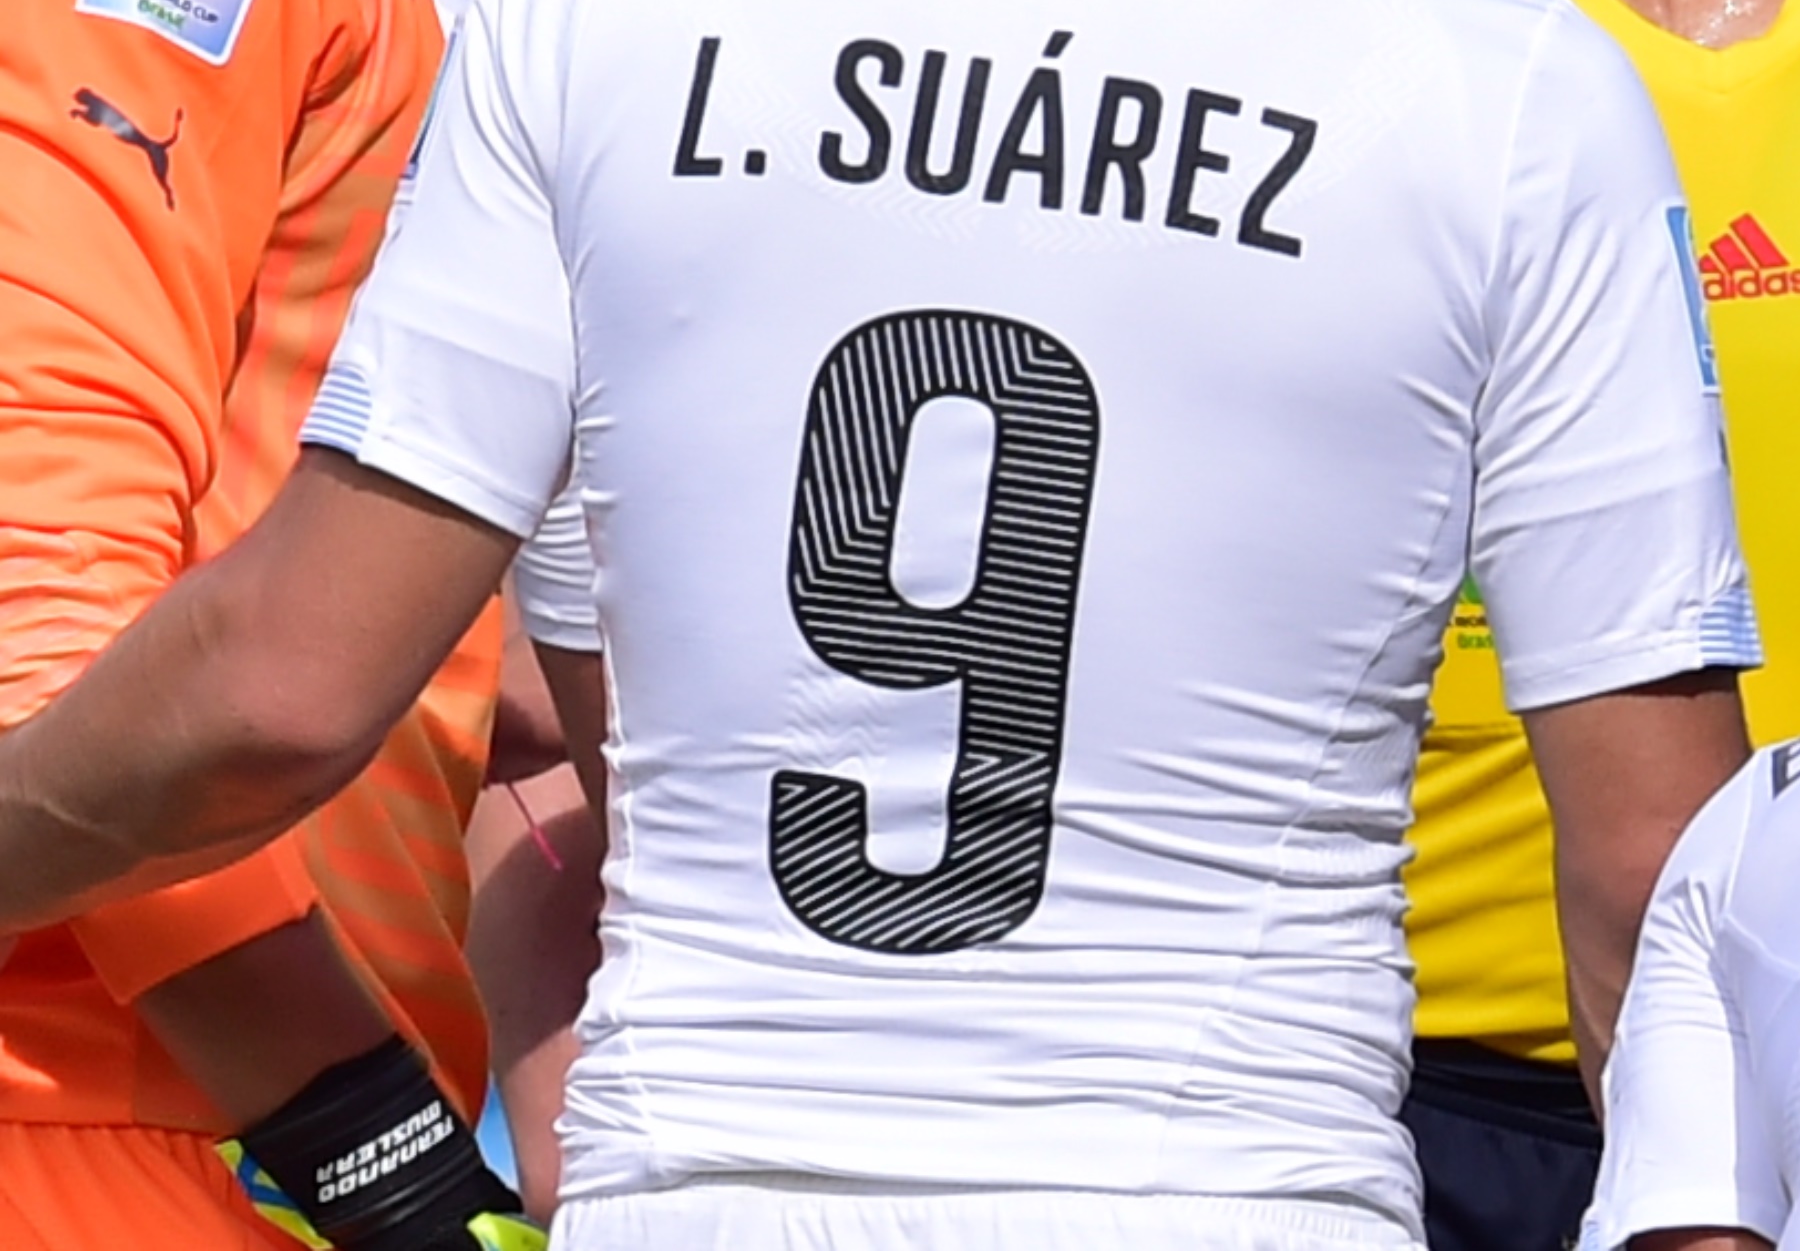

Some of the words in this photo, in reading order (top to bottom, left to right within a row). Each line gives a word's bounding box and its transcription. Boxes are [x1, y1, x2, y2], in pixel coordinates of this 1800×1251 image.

[193, 6, 218, 23] CUP
[672, 37, 767, 177] L.
[818, 30, 1318, 258] SUÁREZ
[767, 307, 1101, 956] 9
[315, 1099, 443, 1184] MUSLERA
[317, 1114, 456, 1204] FERNANDO
